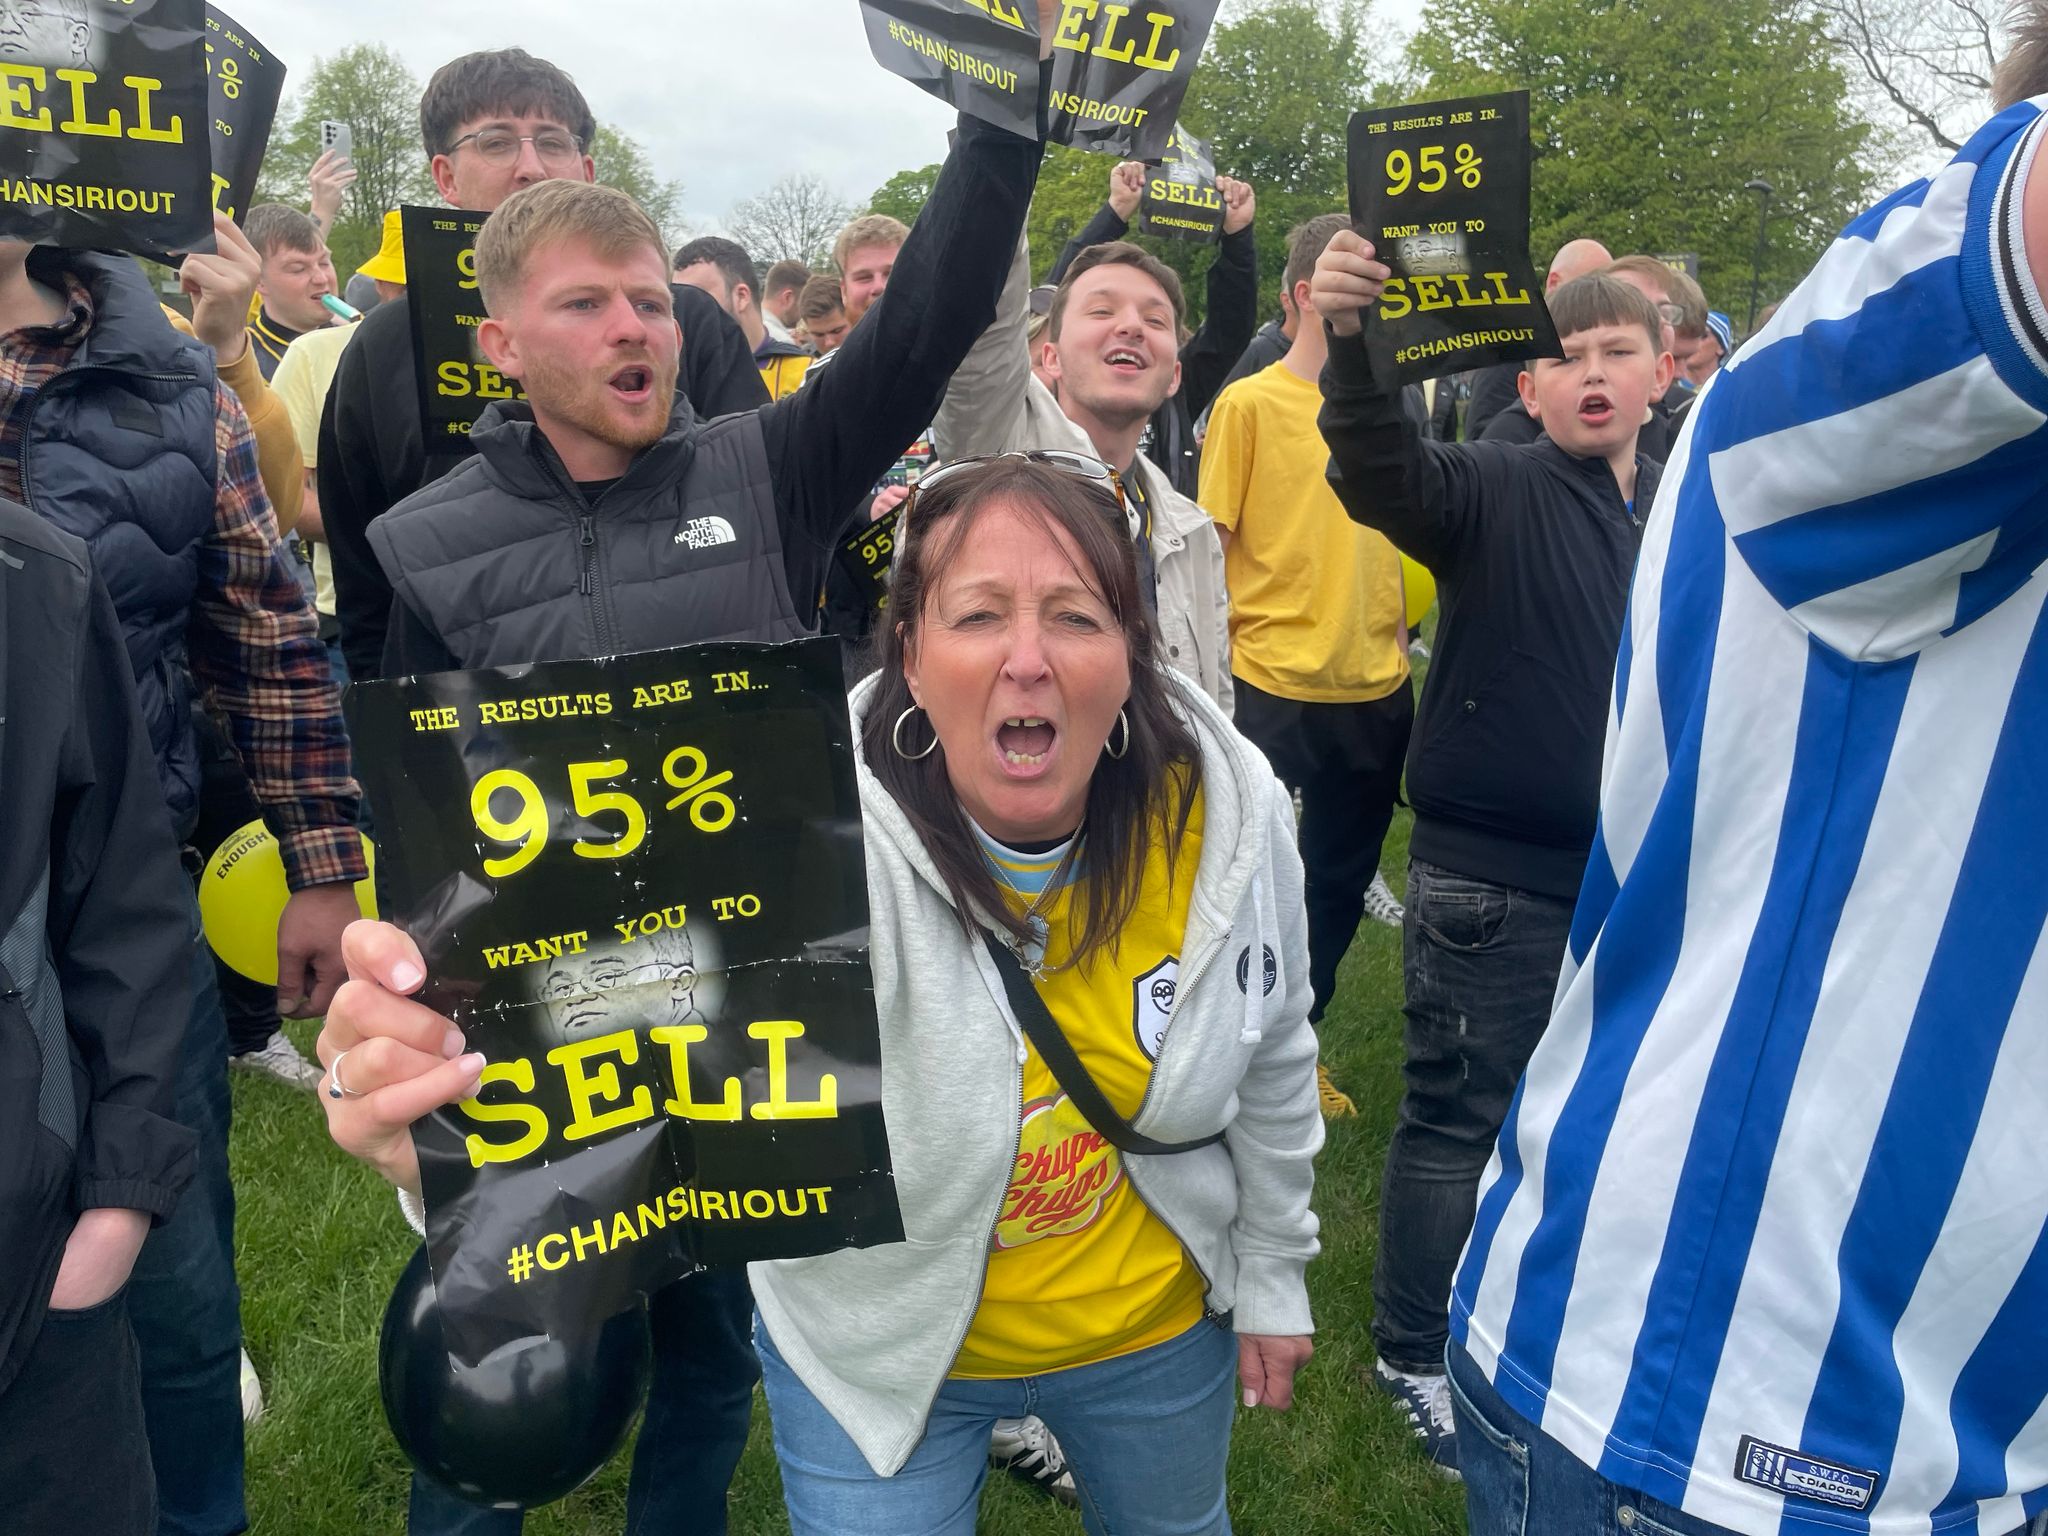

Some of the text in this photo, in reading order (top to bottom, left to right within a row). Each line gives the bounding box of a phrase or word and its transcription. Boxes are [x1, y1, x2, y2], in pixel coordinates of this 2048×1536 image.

[224, 30, 245, 49] ARE
[1052, 0, 1181, 72] ELL
[888, 20, 1018, 94] #CHANSIRIOUT
[0, 62, 184, 144] ELL
[1049, 90, 1149, 128] NSIRIOUT
[215, 118, 233, 136] TO
[1368, 122, 1387, 134] THE
[1392, 115, 1444, 131] RESULTS
[1449, 111, 1473, 124] ARE
[1385, 142, 1483, 196] 95%
[0, 178, 176, 214] HANSIRIOUT
[1150, 178, 1221, 210] SELL
[432, 220, 458, 231] THE
[1150, 215, 1215, 233] #CHANSIRIOUT
[1382, 219, 1485, 239] WANT YOU TO
[1378, 271, 1531, 321] SELL
[1395, 328, 1534, 364] #CHANSIRIOUT
[437, 361, 528, 400] SE
[674, 526, 714, 544] NORTH
[687, 516, 711, 530] THE
[688, 535, 717, 550] FACE
[409, 706, 460, 732] THE
[479, 692, 612, 727] RESULTS
[632, 679, 693, 710] ARE
[470, 745, 736, 879] 95%
[216, 832, 269, 880] ENOUGH
[482, 893, 762, 970] WANT YOU TO
[459, 1019, 838, 1169] SELL
[506, 1186, 833, 1284] #CHANSIRIOUT
[1806, 1477, 1861, 1498] DIADORA
